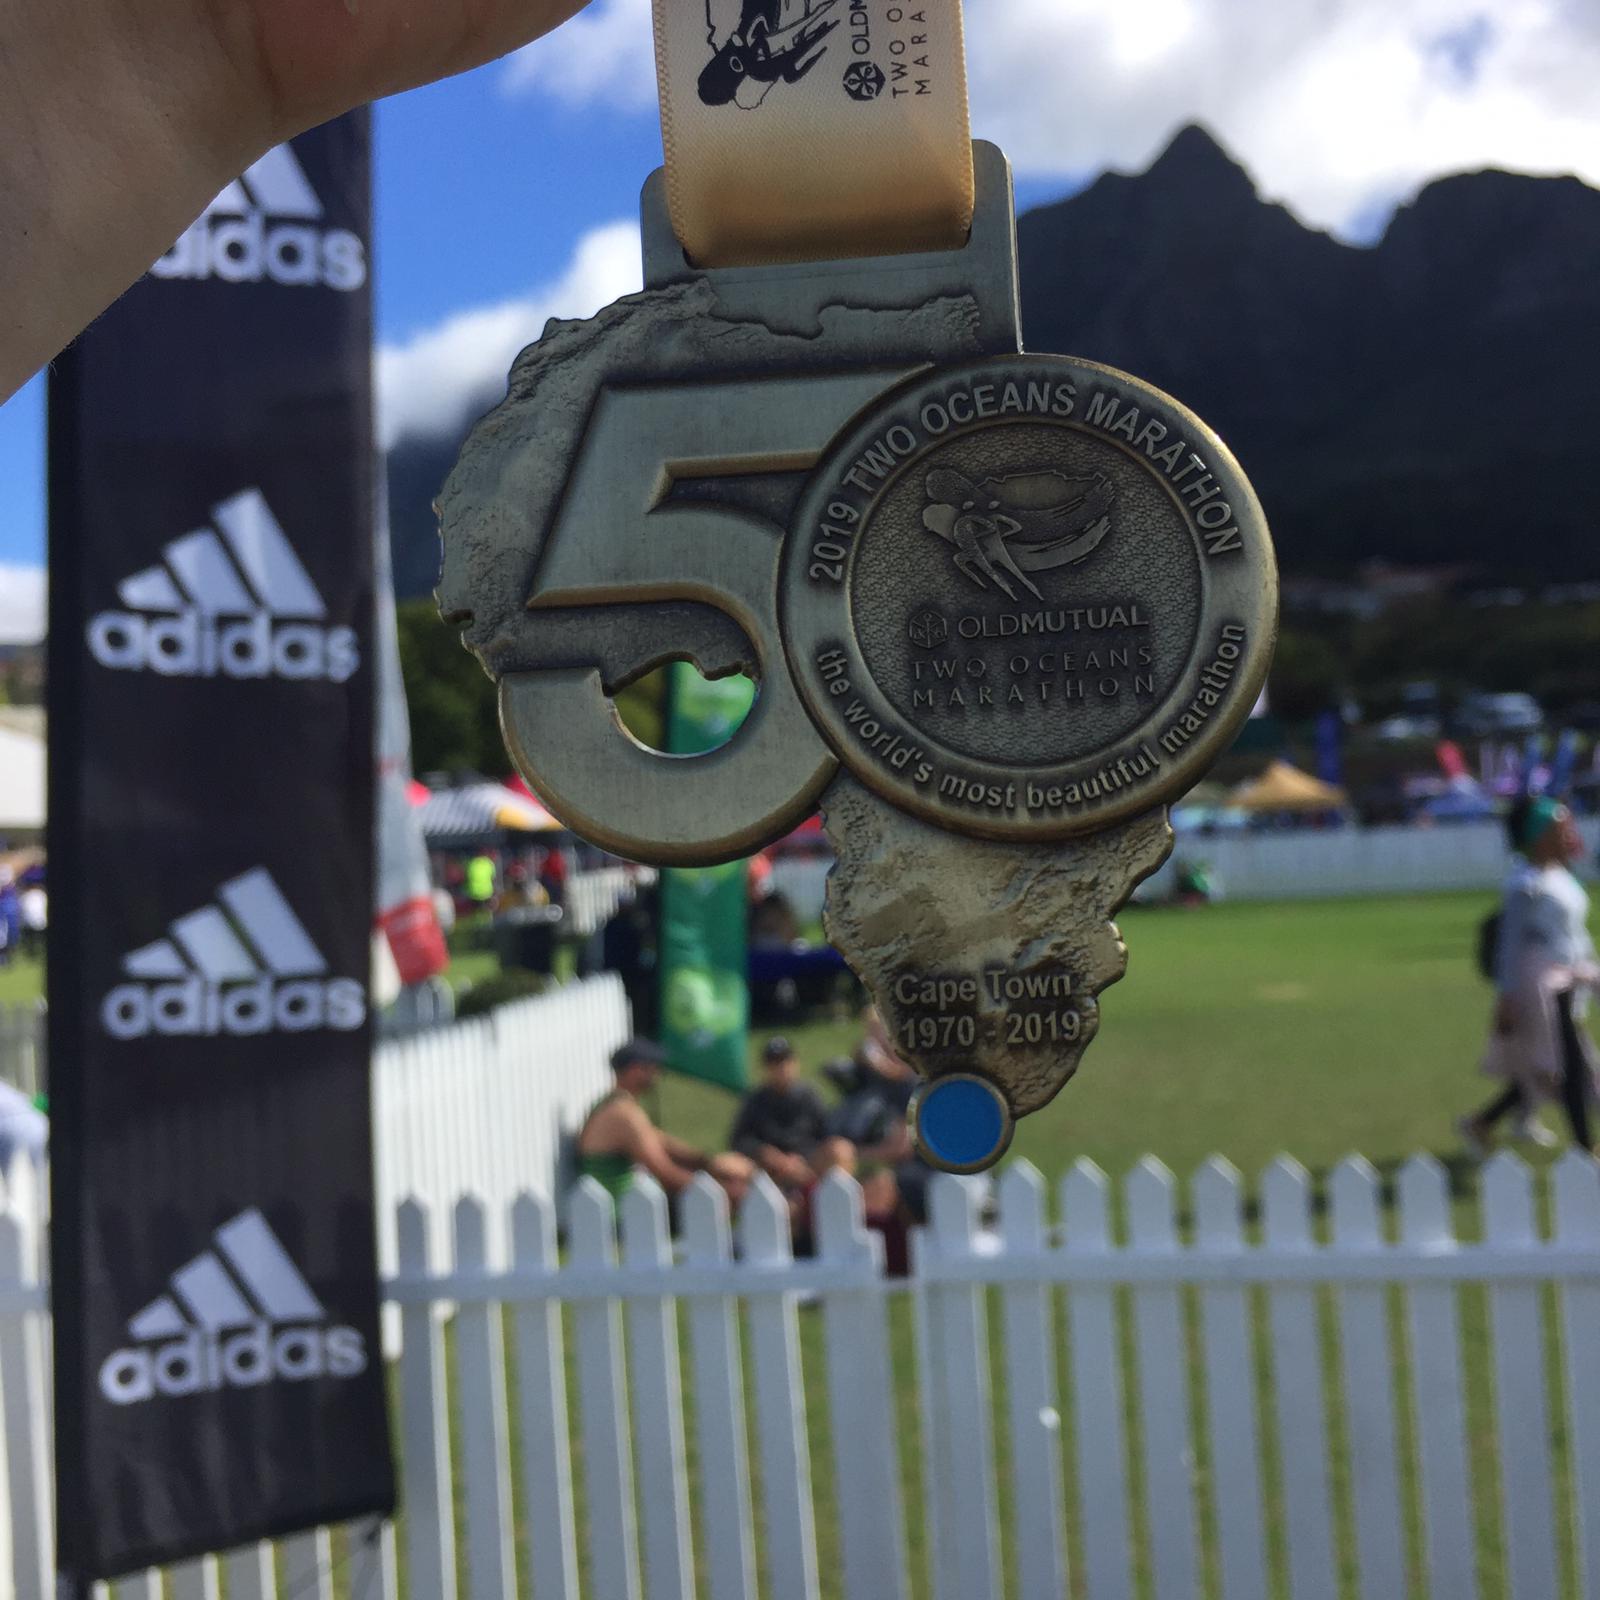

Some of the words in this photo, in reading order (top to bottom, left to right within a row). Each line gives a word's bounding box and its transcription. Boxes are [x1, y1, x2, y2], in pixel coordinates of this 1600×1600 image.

[889, 40, 909, 99] TWO
[908, 0, 932, 95] MARA
[150, 212, 367, 291] didas
[809, 501, 860, 581] 2019
[841, 425, 917, 494] TWO
[920, 381, 1077, 435] OCEANS
[1084, 391, 1242, 555] MARATHON
[85, 603, 360, 683] adidas
[912, 658, 987, 679] TWO
[1009, 646, 1152, 674] OCEANS
[816, 650, 851, 695] the
[844, 699, 934, 782] world's
[939, 773, 1016, 808] most
[1026, 744, 1161, 809] beautiful
[1158, 623, 1246, 753] marathon
[912, 674, 1154, 708] MARATHON
[102, 975, 367, 1040] adidas
[895, 973, 977, 1010] Cape
[985, 969, 1072, 1000] Town
[901, 1015, 975, 1049] 1970
[1005, 1010, 1081, 1044] 2019
[100, 1318, 367, 1405] adidas
